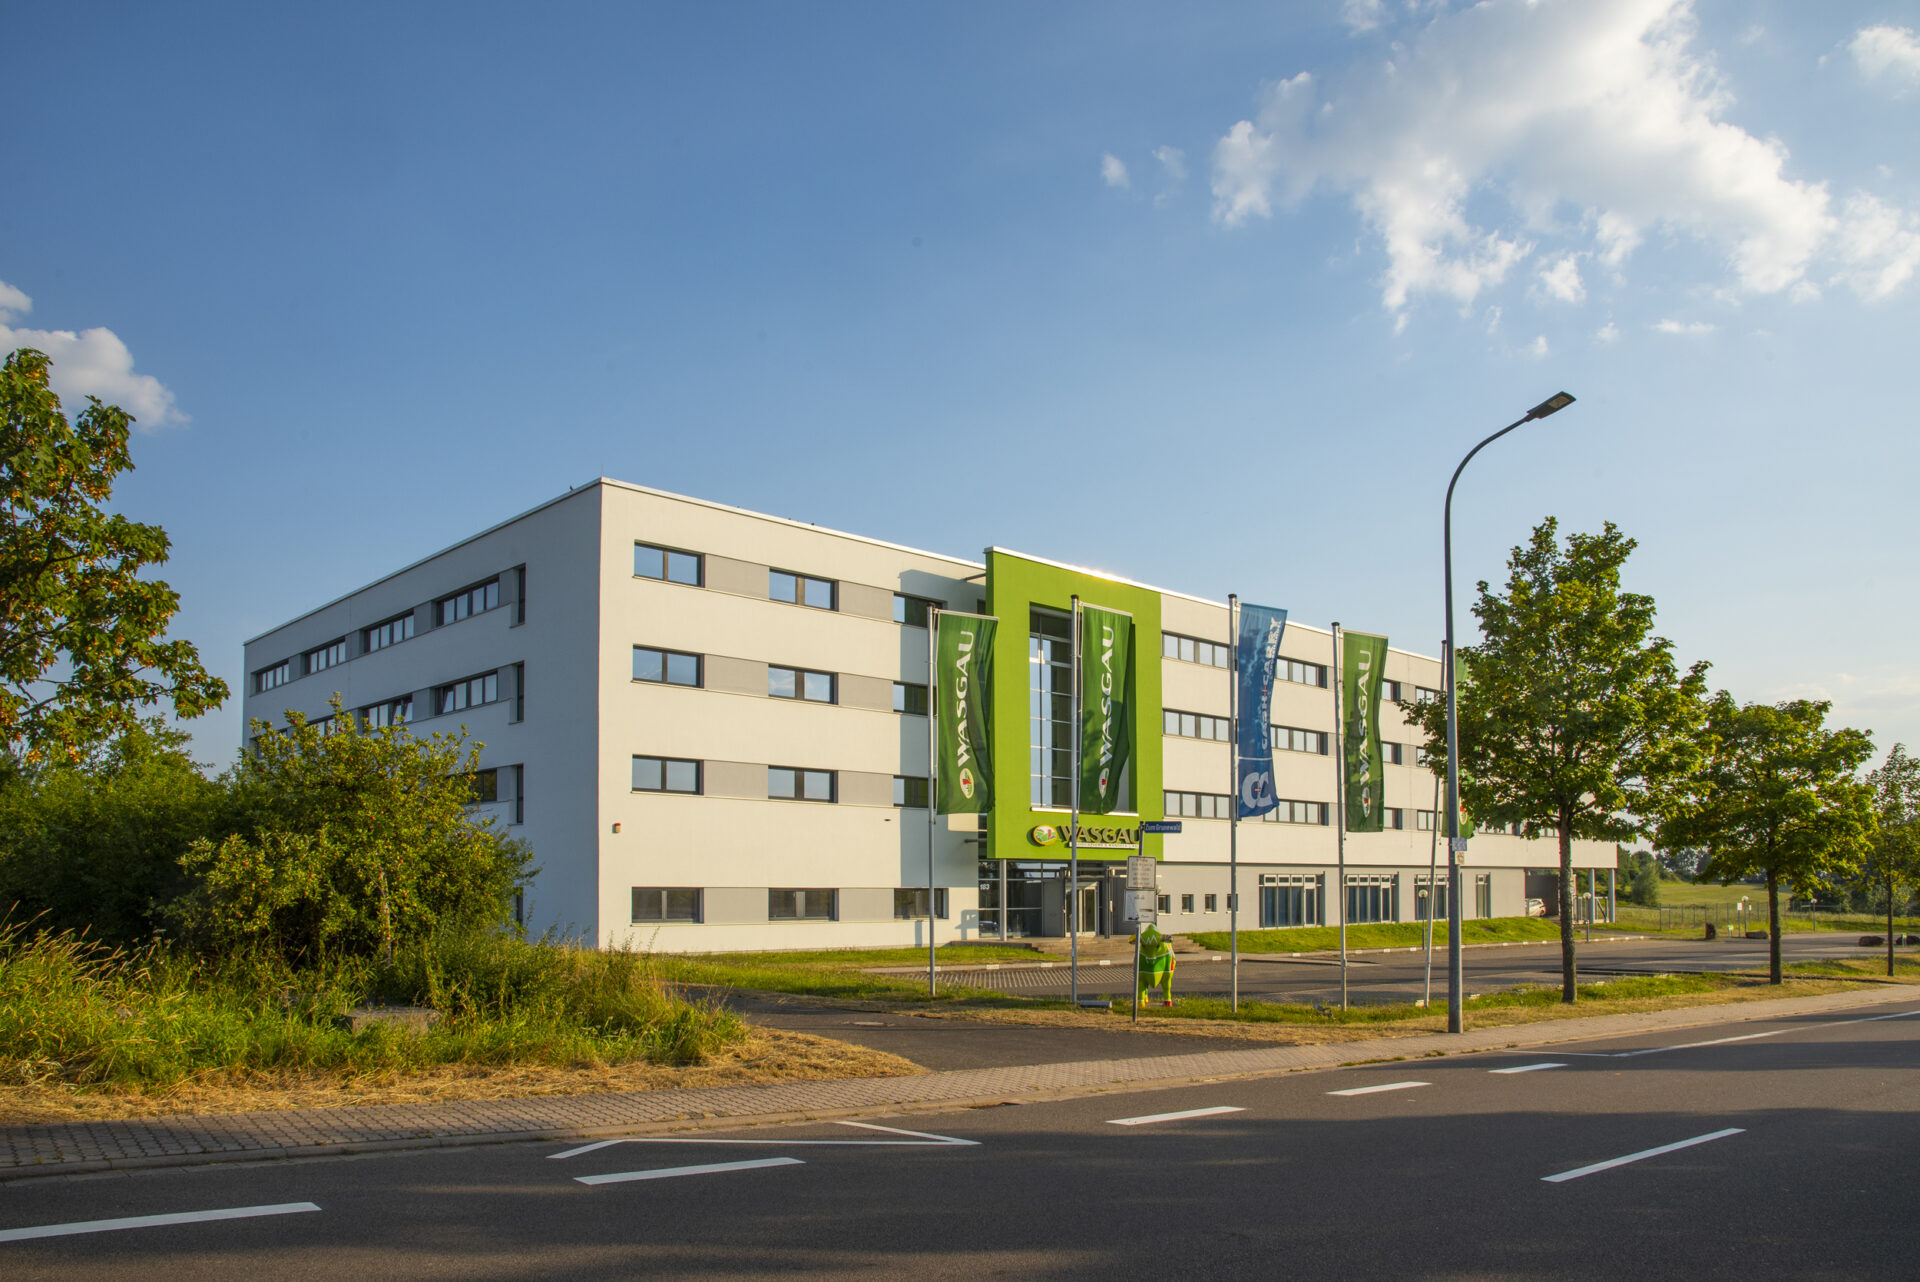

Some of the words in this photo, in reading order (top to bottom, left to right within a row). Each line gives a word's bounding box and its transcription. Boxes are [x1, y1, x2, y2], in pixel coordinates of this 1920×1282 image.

[956, 630, 974, 768] WASGAU
[1100, 626, 1115, 767] WASGAU
[1358, 649, 1372, 785] WASGAU
[1060, 825, 1140, 844] WASGAU
